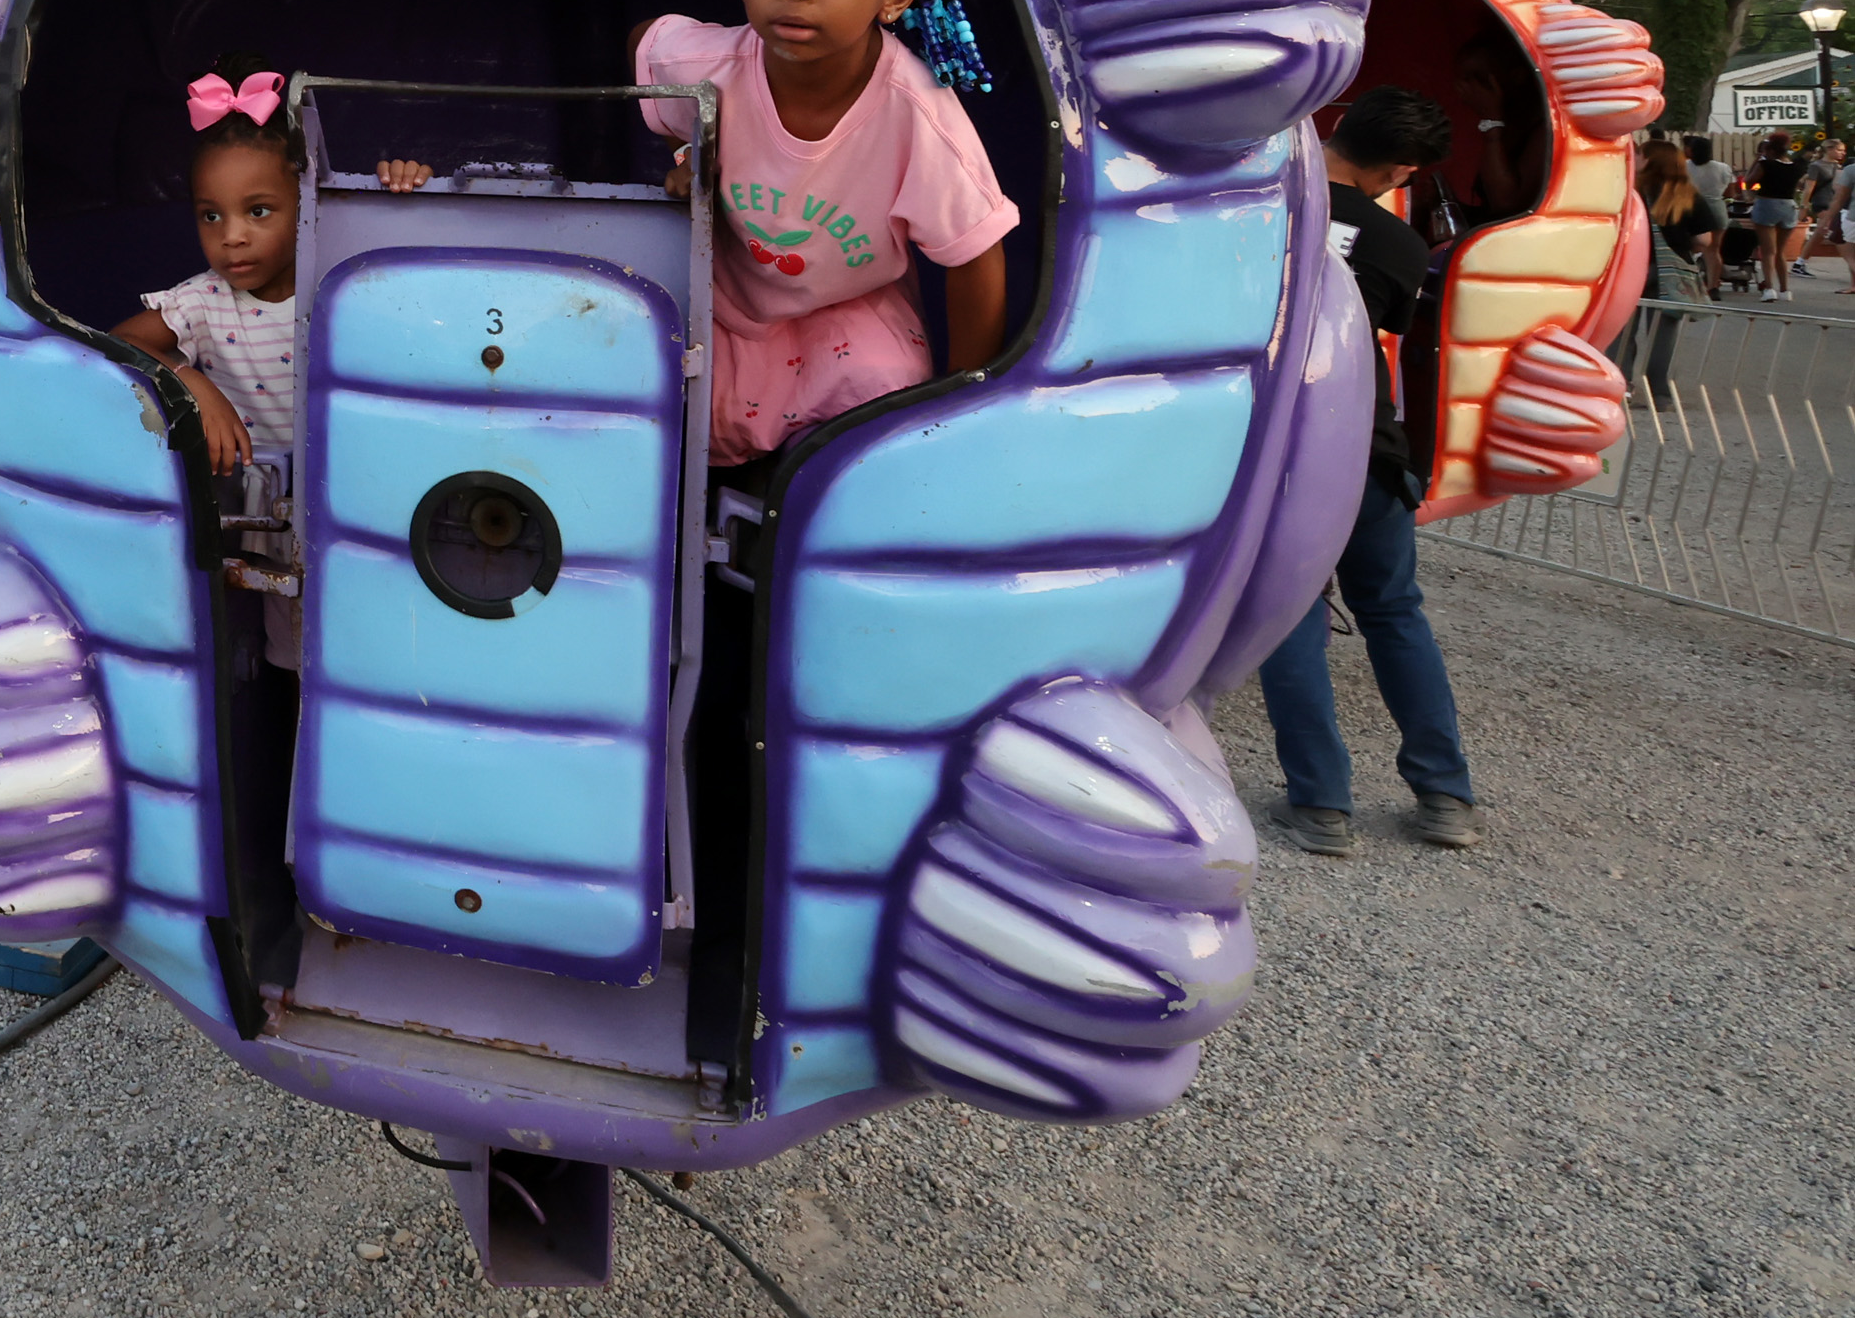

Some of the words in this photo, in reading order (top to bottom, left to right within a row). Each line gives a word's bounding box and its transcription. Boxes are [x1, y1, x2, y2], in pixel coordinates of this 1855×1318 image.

[1744, 94, 1807, 106] FAIRBOARD
[1745, 105, 1809, 120] OFFICE
[720, 183, 787, 215] EET
[802, 193, 875, 268] VIBES
[486, 307, 504, 335] 3
